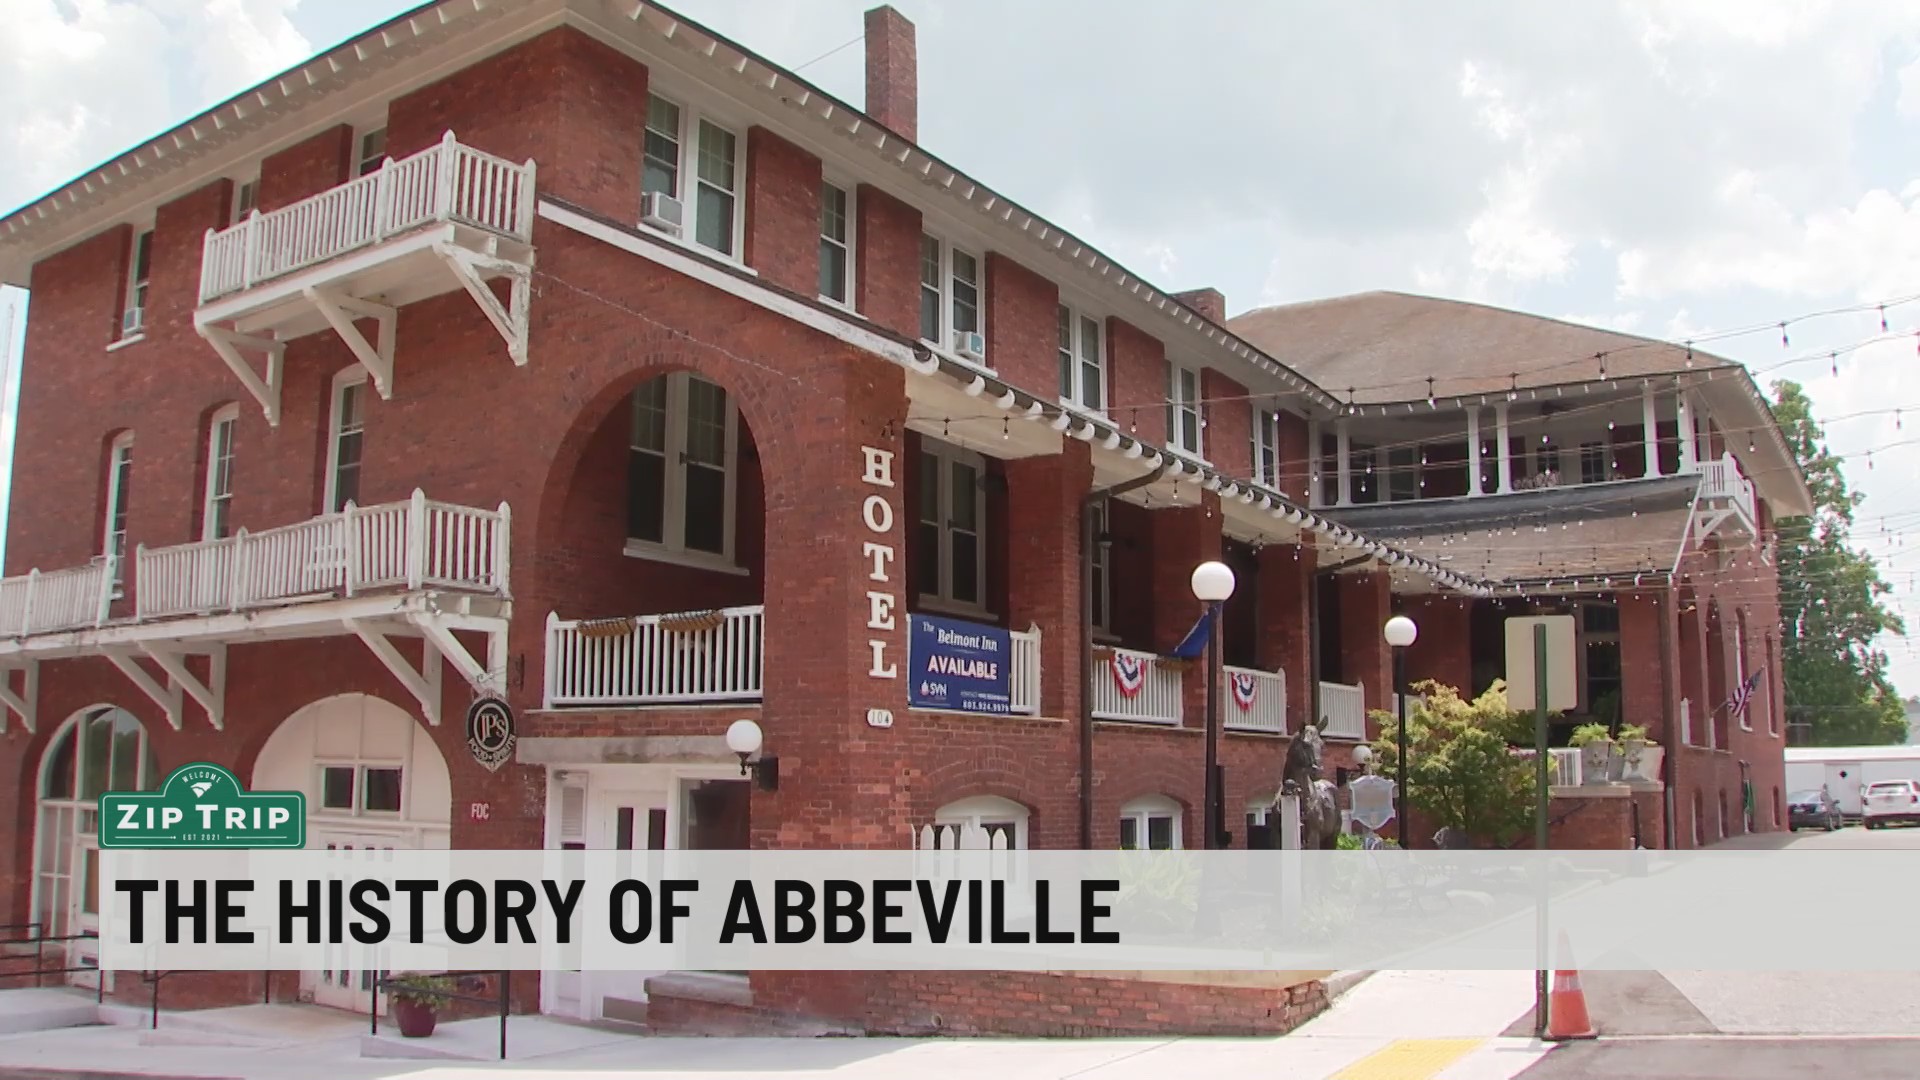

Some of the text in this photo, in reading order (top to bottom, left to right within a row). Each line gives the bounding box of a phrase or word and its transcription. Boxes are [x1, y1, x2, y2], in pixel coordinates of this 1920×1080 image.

[861, 445, 897, 679] HOTEL
[922, 621, 935, 633] The
[937, 628, 998, 652] Belmont Inn
[927, 654, 998, 680] AVAILABLE
